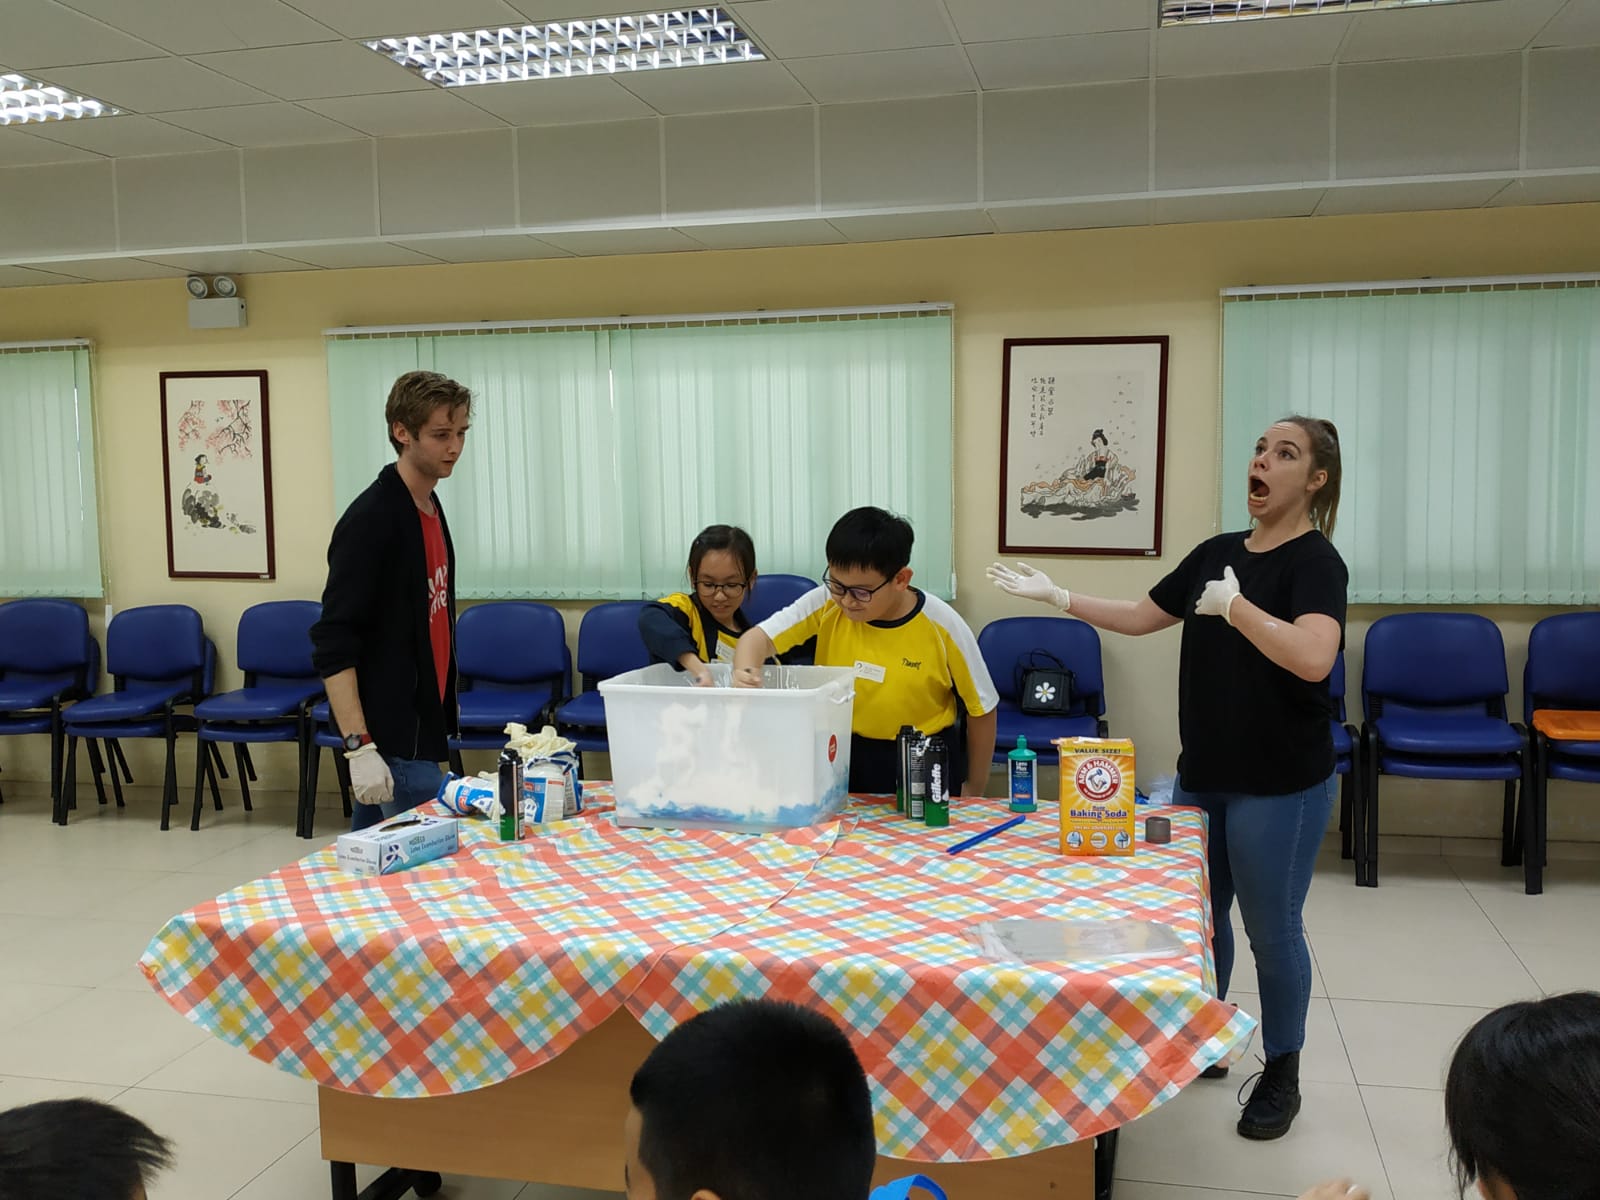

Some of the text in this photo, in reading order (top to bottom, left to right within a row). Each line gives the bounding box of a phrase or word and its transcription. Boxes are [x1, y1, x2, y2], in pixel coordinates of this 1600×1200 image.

[931, 763, 942, 803] Gillette
[1094, 760, 1119, 784] HAMMER
[1070, 809, 1127, 819] Baking Soda
